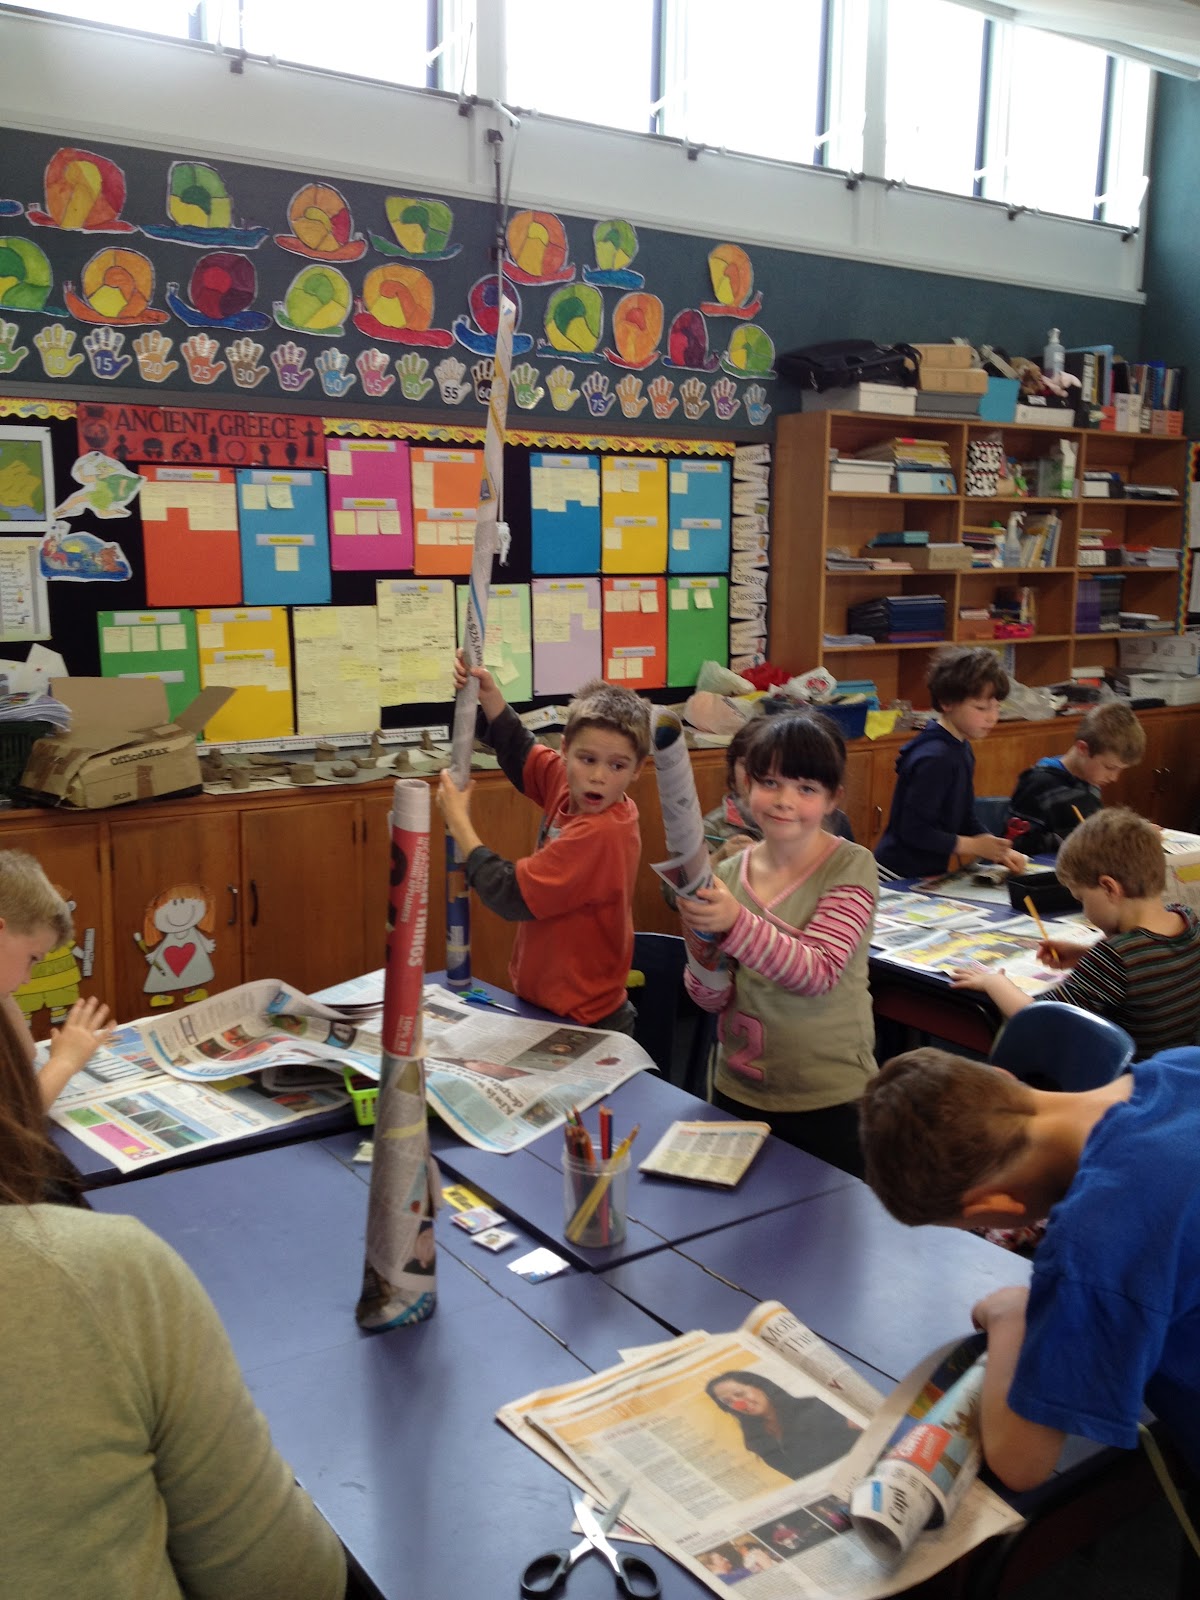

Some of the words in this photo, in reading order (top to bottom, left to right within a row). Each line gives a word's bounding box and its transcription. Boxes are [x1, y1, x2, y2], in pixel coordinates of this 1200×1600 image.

[48, 356, 65, 369] 10
[95, 356, 113, 371] 15
[144, 361, 162, 375] 20
[193, 364, 211, 379] 25
[237, 368, 254, 382] 30
[282, 372, 300, 386] 35
[325, 378, 342, 391] 40
[367, 379, 382, 391] 45
[405, 382, 421, 395] 50
[444, 386, 459, 399] 55
[518, 391, 533, 403] 65
[591, 399, 606, 412] 75
[623, 402, 637, 414] 80
[655, 402, 669, 414] 85
[687, 402, 700, 414] 90
[718, 402, 731, 414] 95
[114, 407, 209, 435] ANCIENT
[218, 414, 298, 440] GREECE
[110, 747, 170, 766] OfficeMax
[407, 908, 427, 967] THINGS
